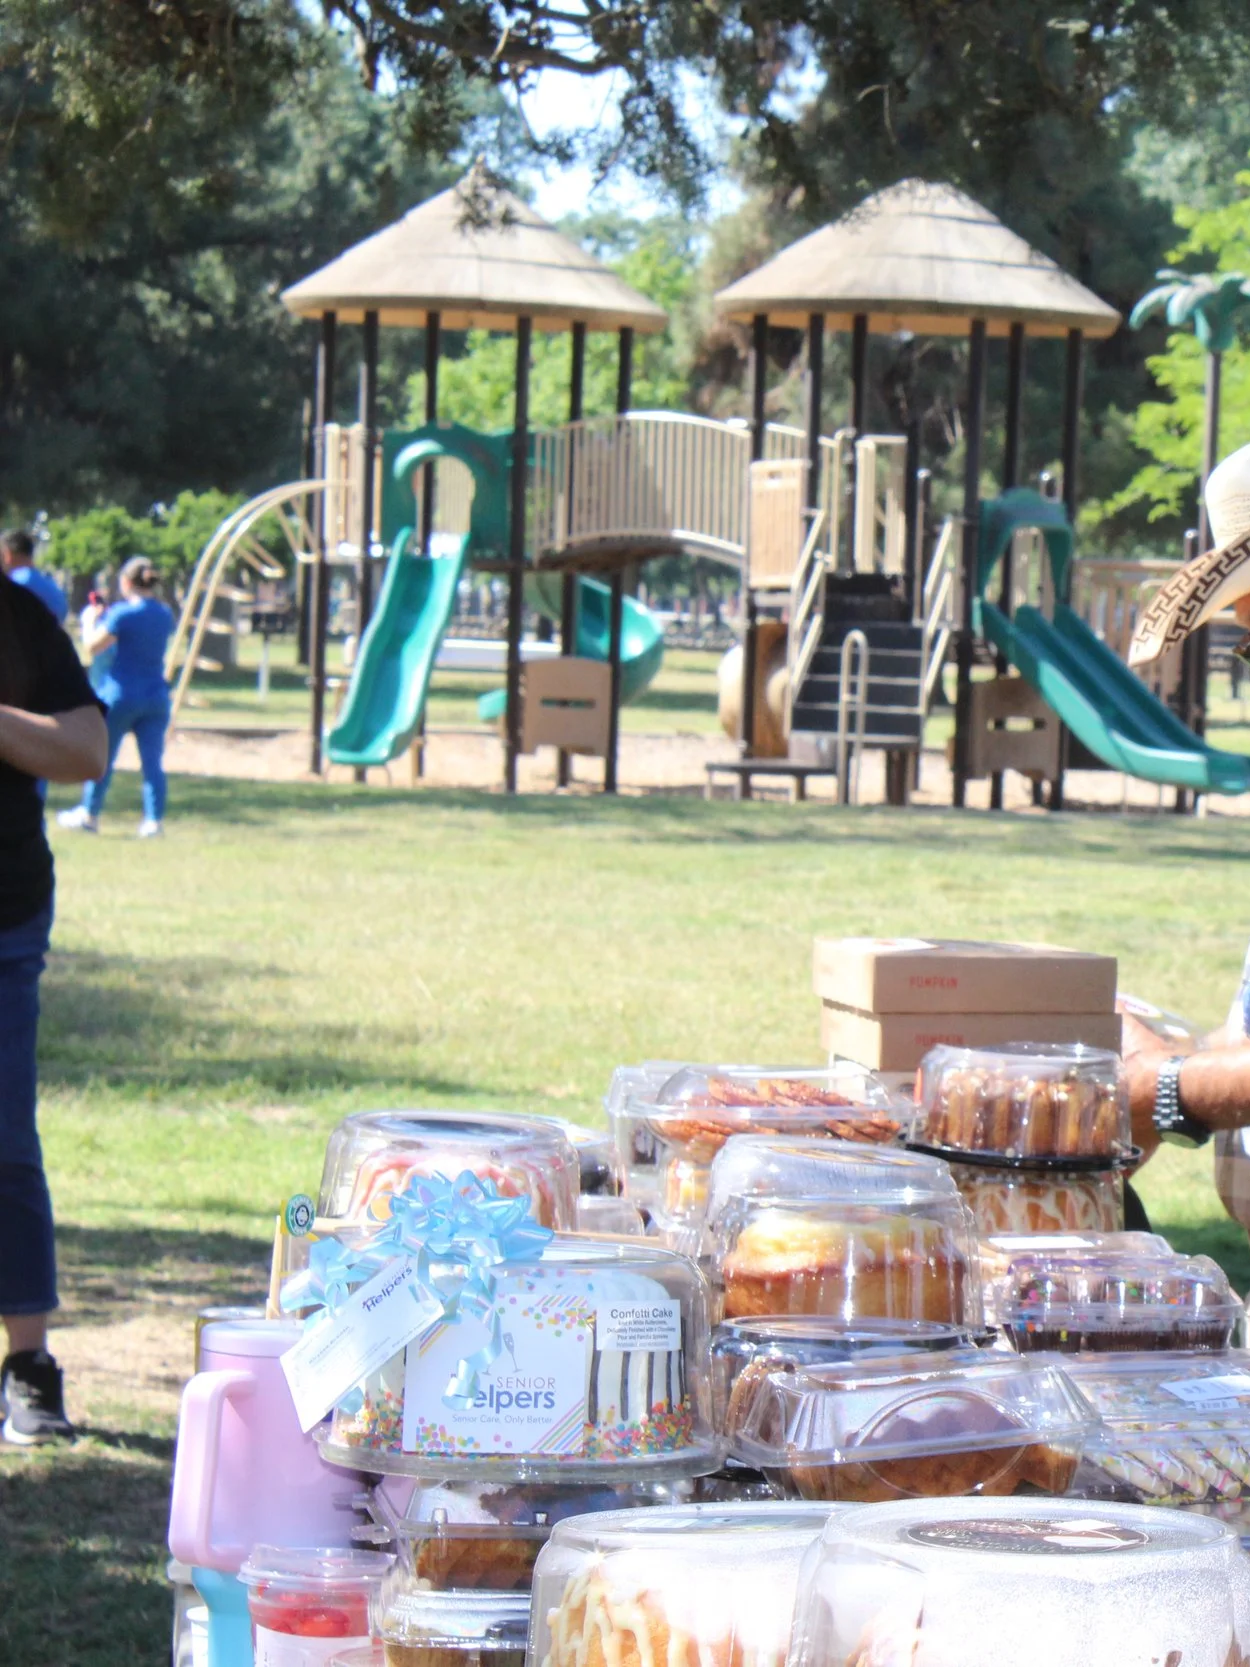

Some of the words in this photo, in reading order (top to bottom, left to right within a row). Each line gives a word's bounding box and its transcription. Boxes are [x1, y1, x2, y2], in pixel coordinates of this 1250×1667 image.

[908, 975, 959, 990] PUMPKIN
[362, 1267, 413, 1312] Helpers
[610, 1308, 650, 1319] Confetti
[652, 1307, 673, 1318] Cake
[496, 1377, 556, 1389] SENIOR
[473, 1384, 555, 1414] elpers
[452, 1414, 477, 1423] Senior
[504, 1414, 525, 1425] Only
